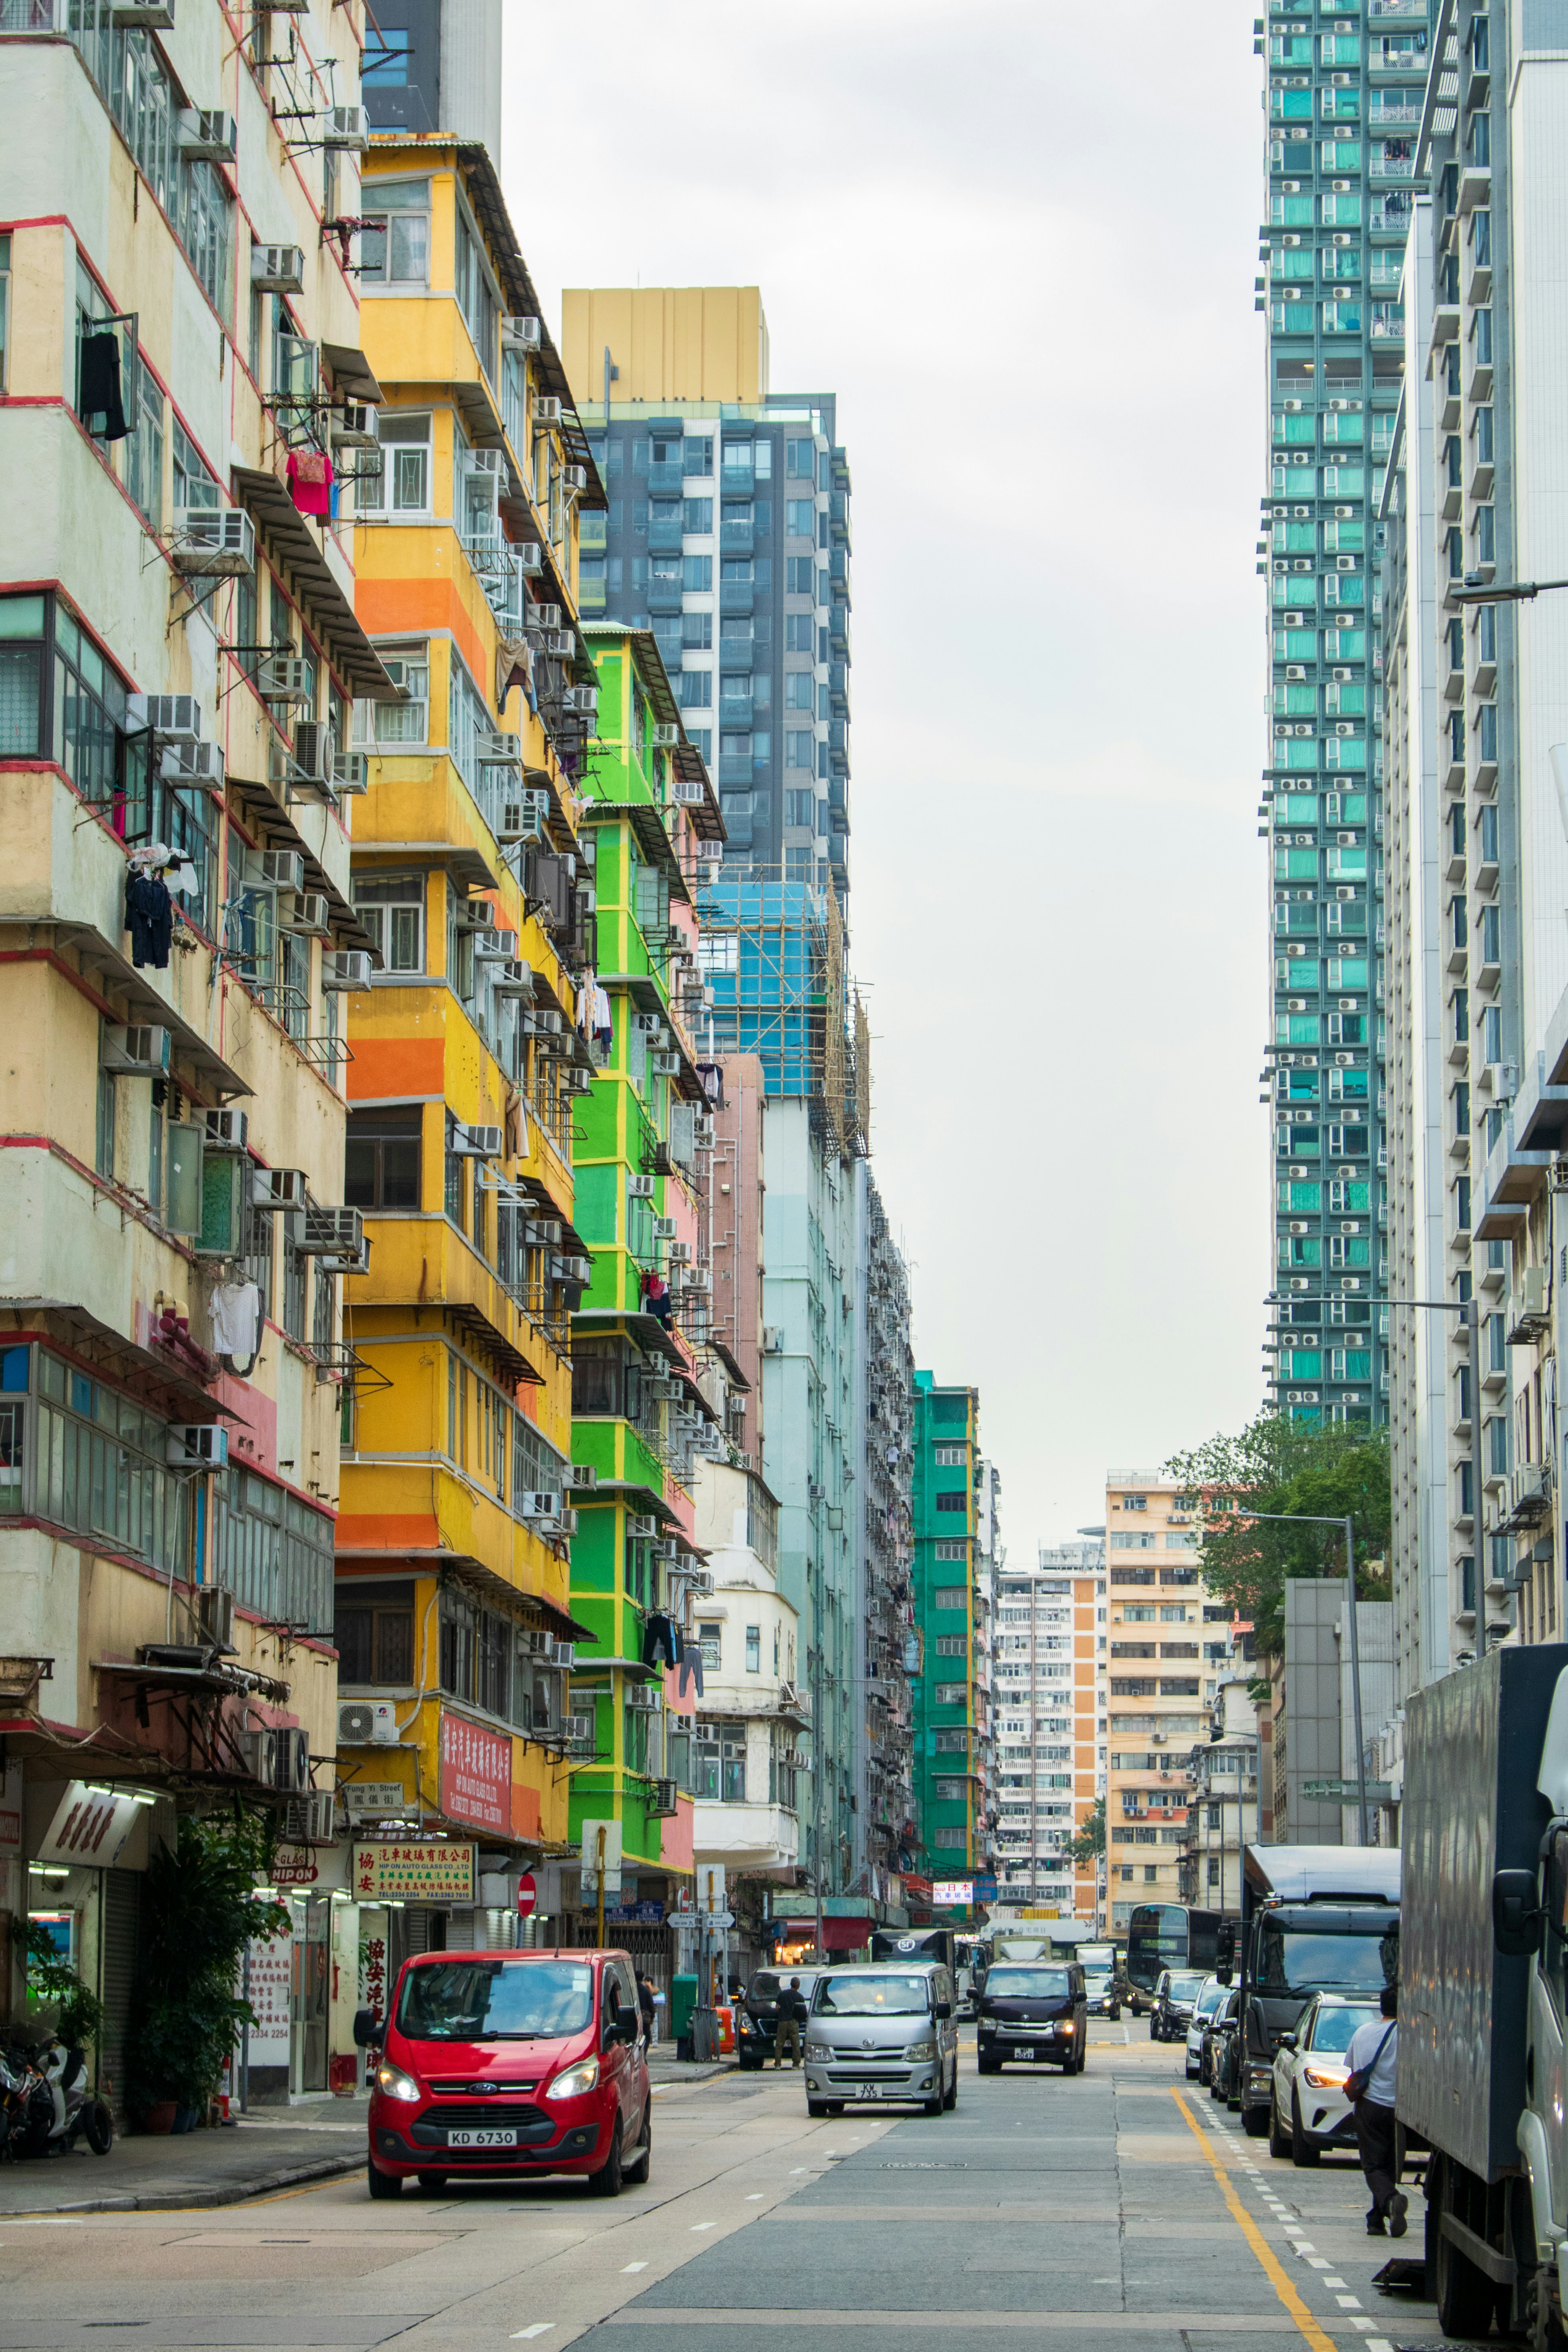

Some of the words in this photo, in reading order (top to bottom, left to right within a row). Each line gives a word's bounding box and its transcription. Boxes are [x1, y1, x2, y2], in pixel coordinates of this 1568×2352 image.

[347, 1785, 364, 1793] Fung
[354, 1794, 393, 1804] 鳳儀街
[281, 1854, 309, 1864] GLAS
[379, 1848, 470, 1862] 汽車玻璃有限公司
[273, 1869, 294, 1880] HIP
[296, 1869, 313, 1880] ON
[357, 1852, 375, 1892] 協安
[365, 1938, 386, 2070] 協安汽車璃
[271, 2029, 288, 2038] 2254
[452, 2133, 470, 2144] KD
[476, 2132, 513, 2144] 6730
